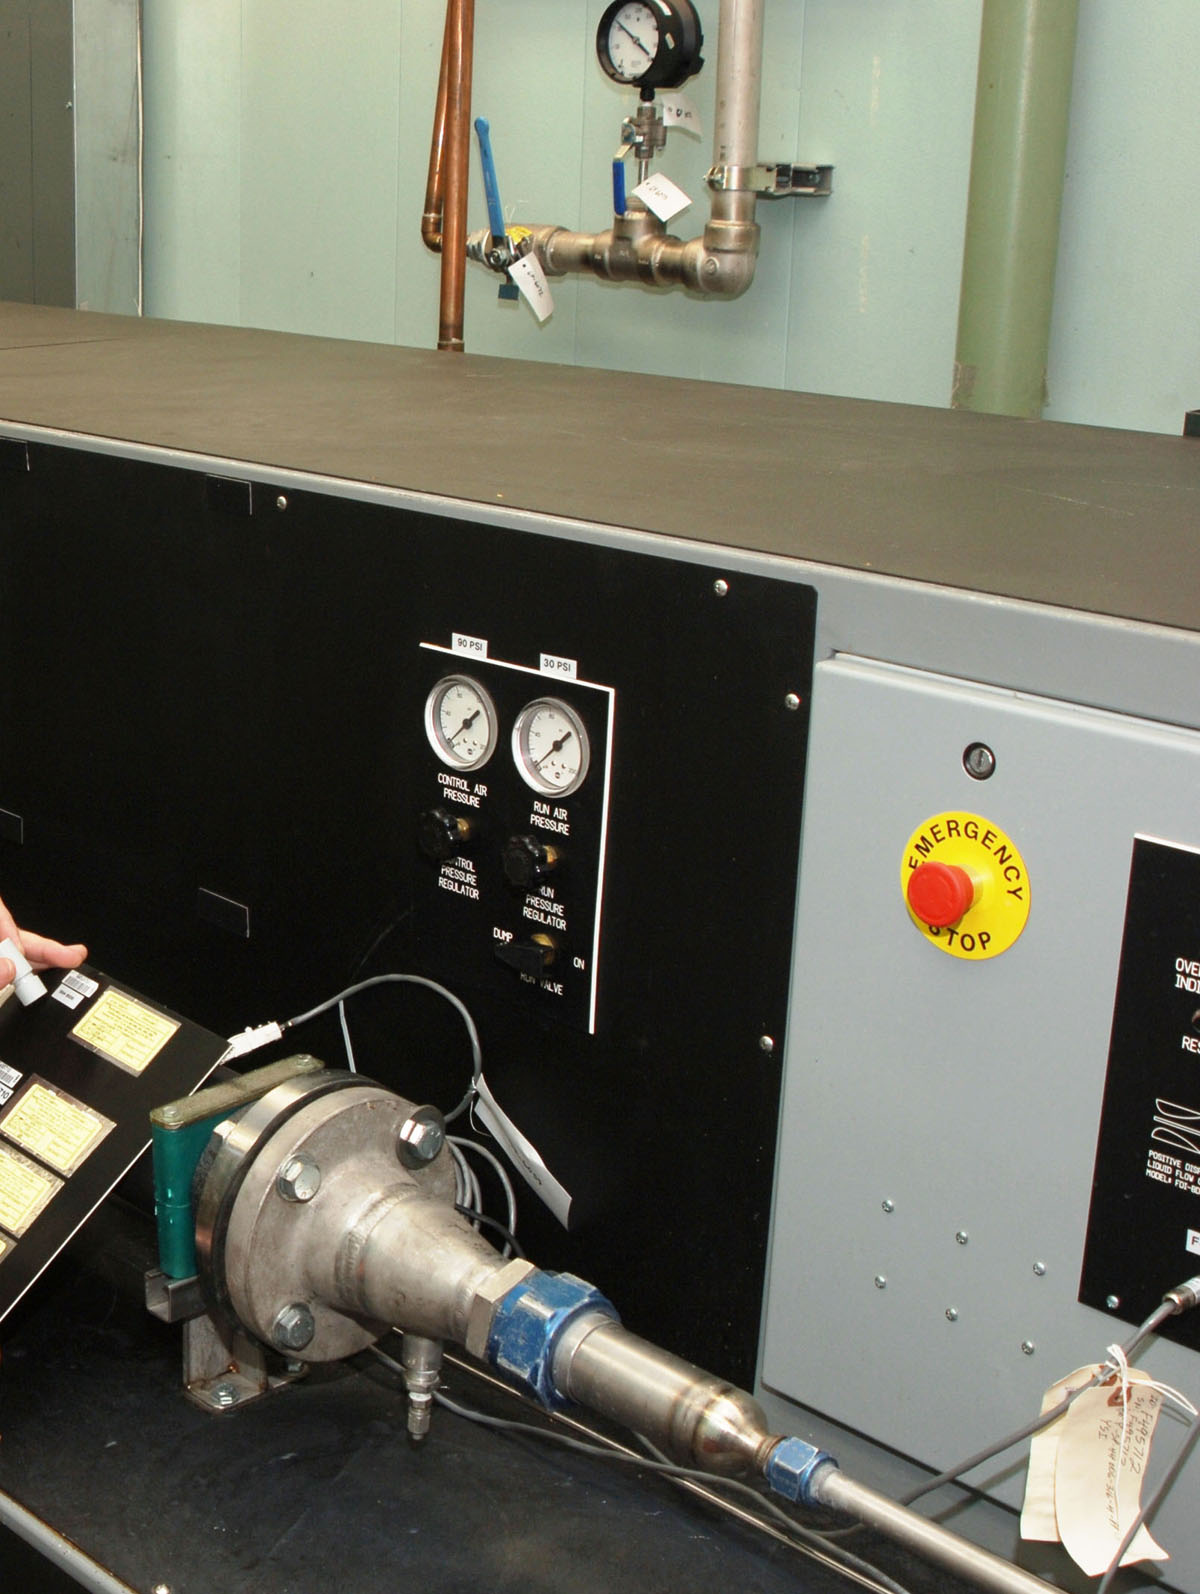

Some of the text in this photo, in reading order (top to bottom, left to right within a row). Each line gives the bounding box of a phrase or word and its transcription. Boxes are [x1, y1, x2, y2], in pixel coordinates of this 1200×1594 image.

[457, 638, 483, 652] 90 PSI
[543, 658, 571, 672] 30 PSI
[438, 773, 487, 797] CONTROL AIR
[443, 788, 480, 808] PRESSURE
[533, 801, 567, 821] RUN AIR
[530, 815, 570, 836] PRESSURE
[908, 819, 1023, 901] EMERGENCY
[441, 865, 477, 886] PRESSURE
[438, 876, 479, 900] REGULATOR
[525, 894, 564, 917] PRESSURE
[523, 906, 567, 931] REGULATOR
[493, 927, 513, 942] DUMP
[573, 957, 585, 970] ON
[1175, 957, 1200, 977] OVE
[1148, 1149, 1182, 1169] POSITIVE
[1147, 1159, 1172, 1175] LIQUID
[1175, 1169, 1194, 1182] FLOW
